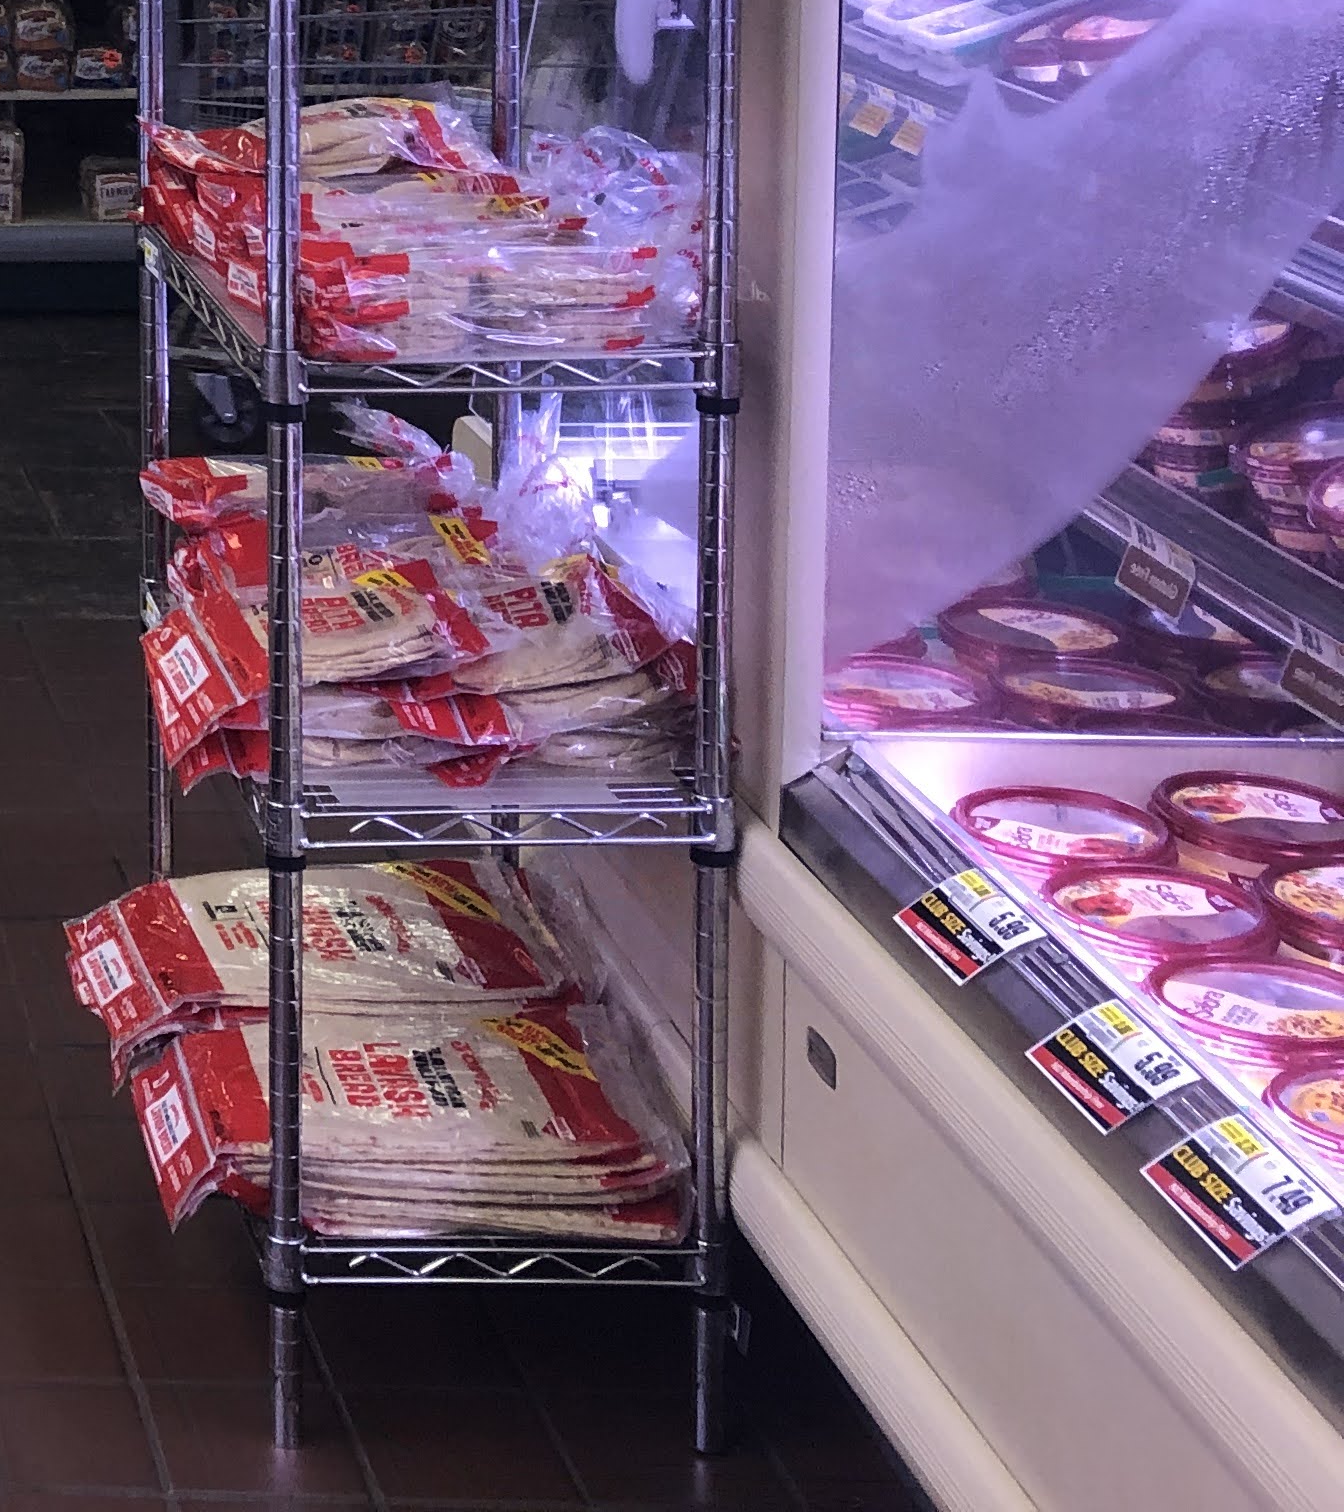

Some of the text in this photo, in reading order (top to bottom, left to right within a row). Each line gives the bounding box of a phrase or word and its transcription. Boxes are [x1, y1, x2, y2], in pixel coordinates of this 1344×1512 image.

[920, 892, 947, 920] CLUB
[941, 912, 966, 935] SIZE
[987, 910, 1030, 941] 5.99
[1055, 1028, 1085, 1057] CLUB
[1078, 1050, 1109, 1079] SIZE
[1133, 1051, 1181, 1086] 5.99
[328, 1049, 381, 1108] BREAD
[363, 1041, 433, 1118] LAVASH
[1173, 1144, 1210, 1179] CLUB
[1199, 1173, 1234, 1204] SIZE
[1261, 1174, 1314, 1216] 7.49
